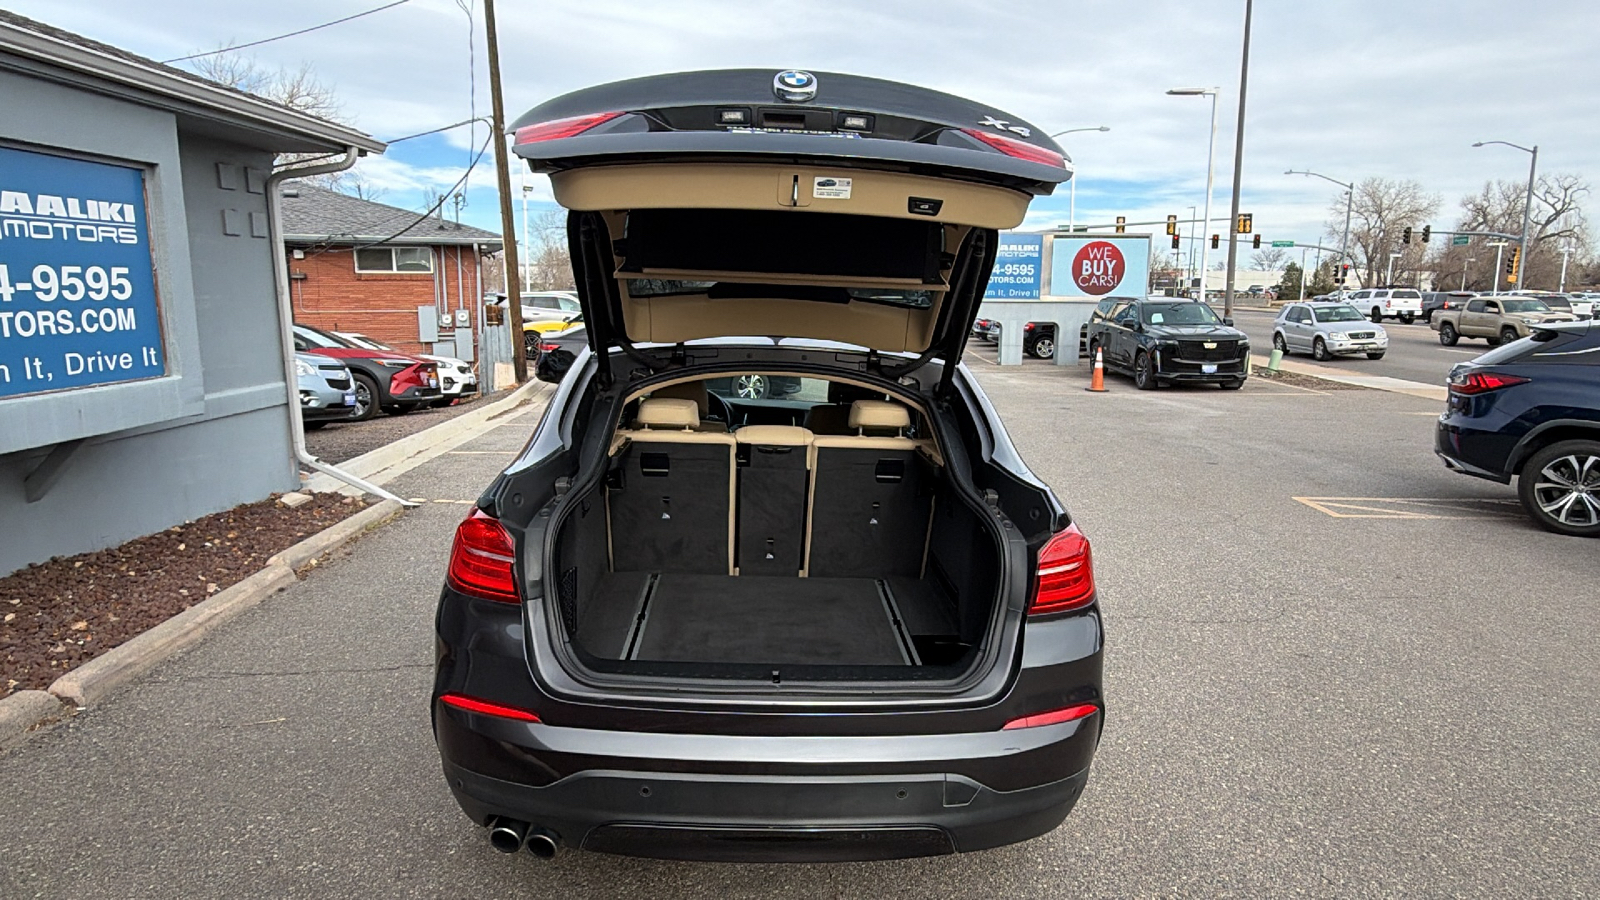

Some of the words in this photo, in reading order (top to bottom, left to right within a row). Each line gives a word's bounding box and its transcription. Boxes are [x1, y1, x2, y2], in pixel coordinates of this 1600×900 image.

[977, 115, 1030, 137] X4
[0, 190, 136, 223] AALIKI
[3, 219, 138, 245] MOTORS
[1088, 246, 1112, 260] WE
[992, 263, 1035, 275] 4-9595
[1082, 259, 1117, 275] BUY
[1078, 274, 1118, 287] CARS!
[1009, 288, 1031, 297] Drive
[24, 357, 53, 382] It,
[64, 350, 133, 376] Drive
[142, 346, 158, 367] It
